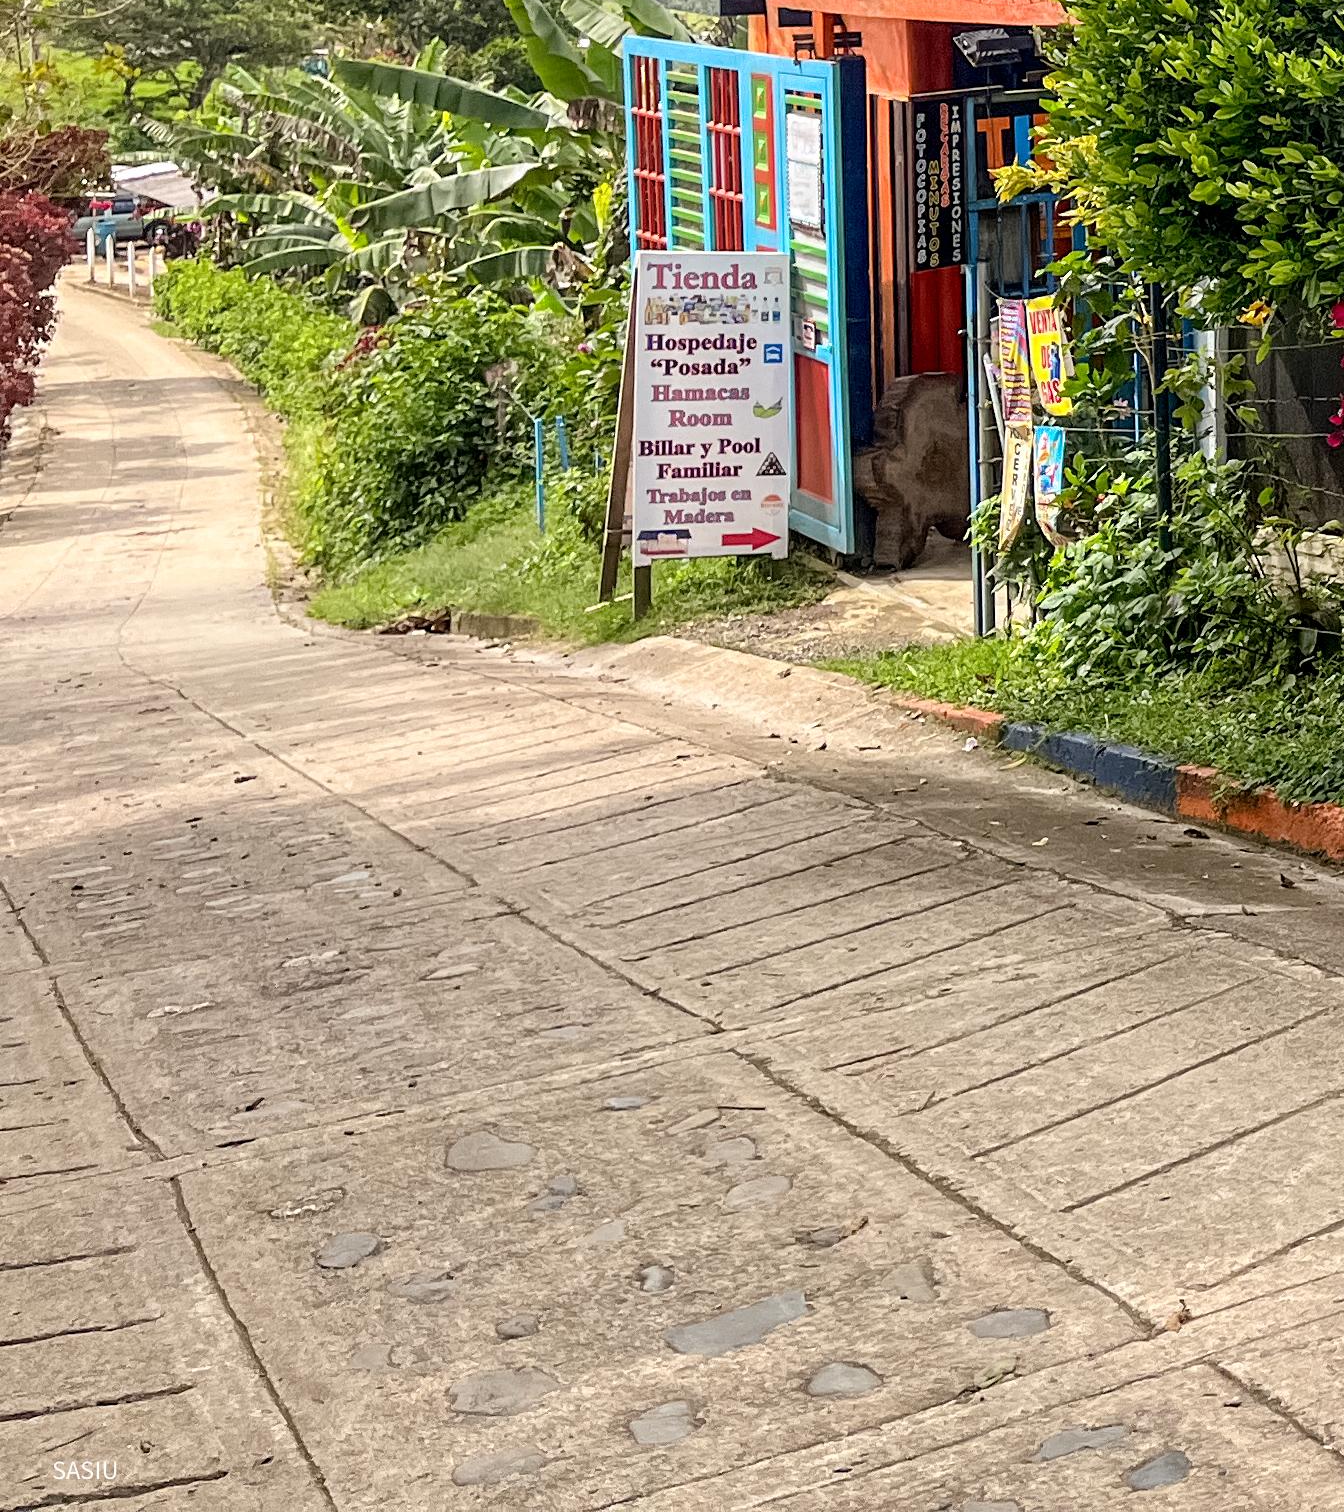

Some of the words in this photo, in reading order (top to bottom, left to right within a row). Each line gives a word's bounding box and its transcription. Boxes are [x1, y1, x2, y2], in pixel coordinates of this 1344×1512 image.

[916, 113, 927, 264] FOTOCOPIAS
[950, 106, 962, 262] IMPRESIONES
[928, 160, 940, 267] MINUTOS
[647, 262, 758, 290] Tienda
[1029, 309, 1057, 334] VENTA
[645, 333, 757, 356] Hospedaje
[650, 358, 751, 376] “Posada”
[651, 384, 750, 402] Hamacas
[1041, 379, 1062, 404] GAS
[668, 409, 733, 428] Room
[638, 440, 695, 456] Billar
[700, 442, 712, 459] y
[717, 438, 761, 454] Pool
[656, 462, 743, 480] Familiar
[646, 487, 726, 506] Trabajos
[731, 489, 752, 502] en
[663, 509, 735, 525] Madera
